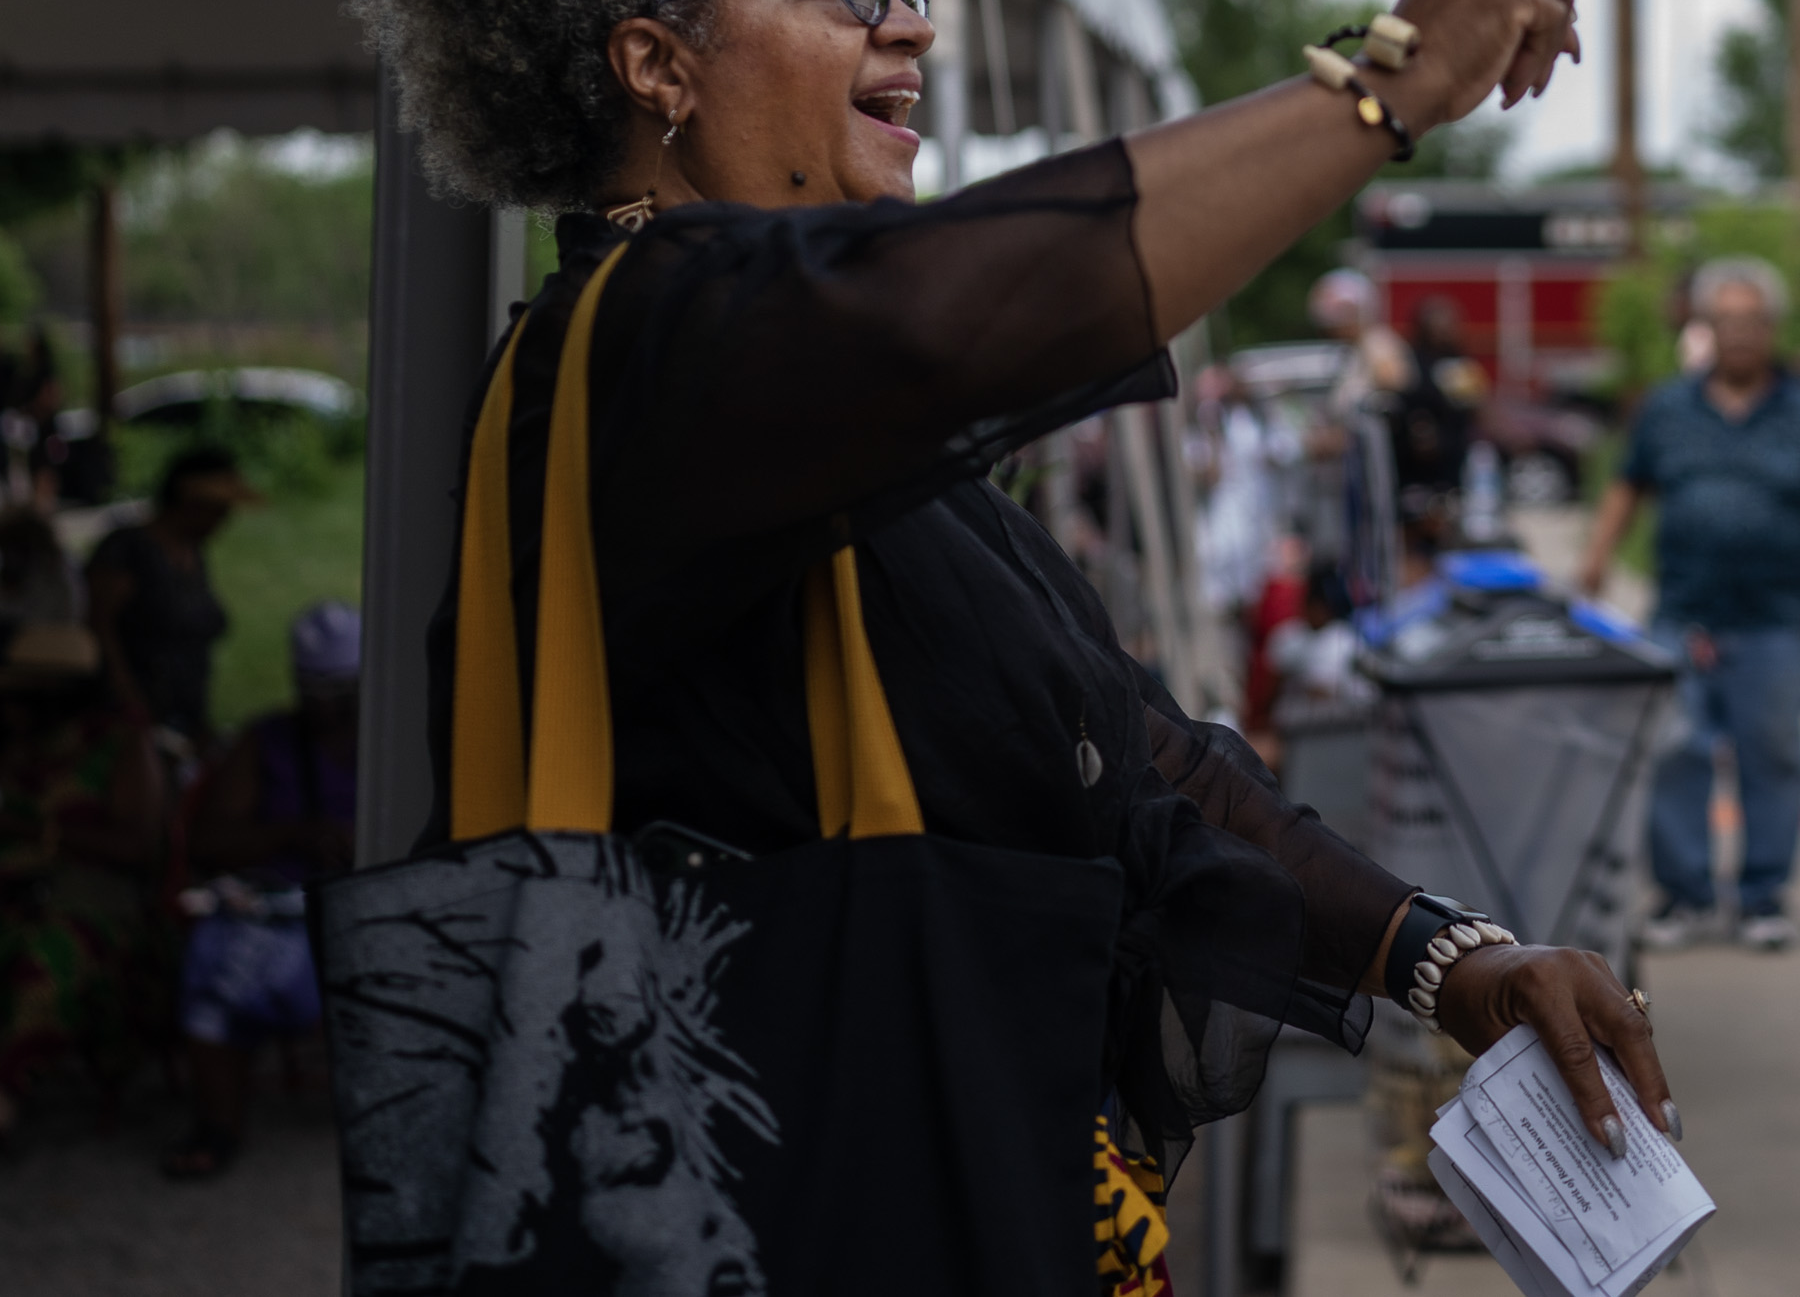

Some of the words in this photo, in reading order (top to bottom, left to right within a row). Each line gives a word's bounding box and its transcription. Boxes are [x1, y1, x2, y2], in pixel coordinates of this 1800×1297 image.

[1520, 1117, 1547, 1150] Awards
[1545, 1151, 1568, 1179] Rondo
[1562, 1178, 1574, 1188] of
[1571, 1188, 1591, 1213] Spirit
